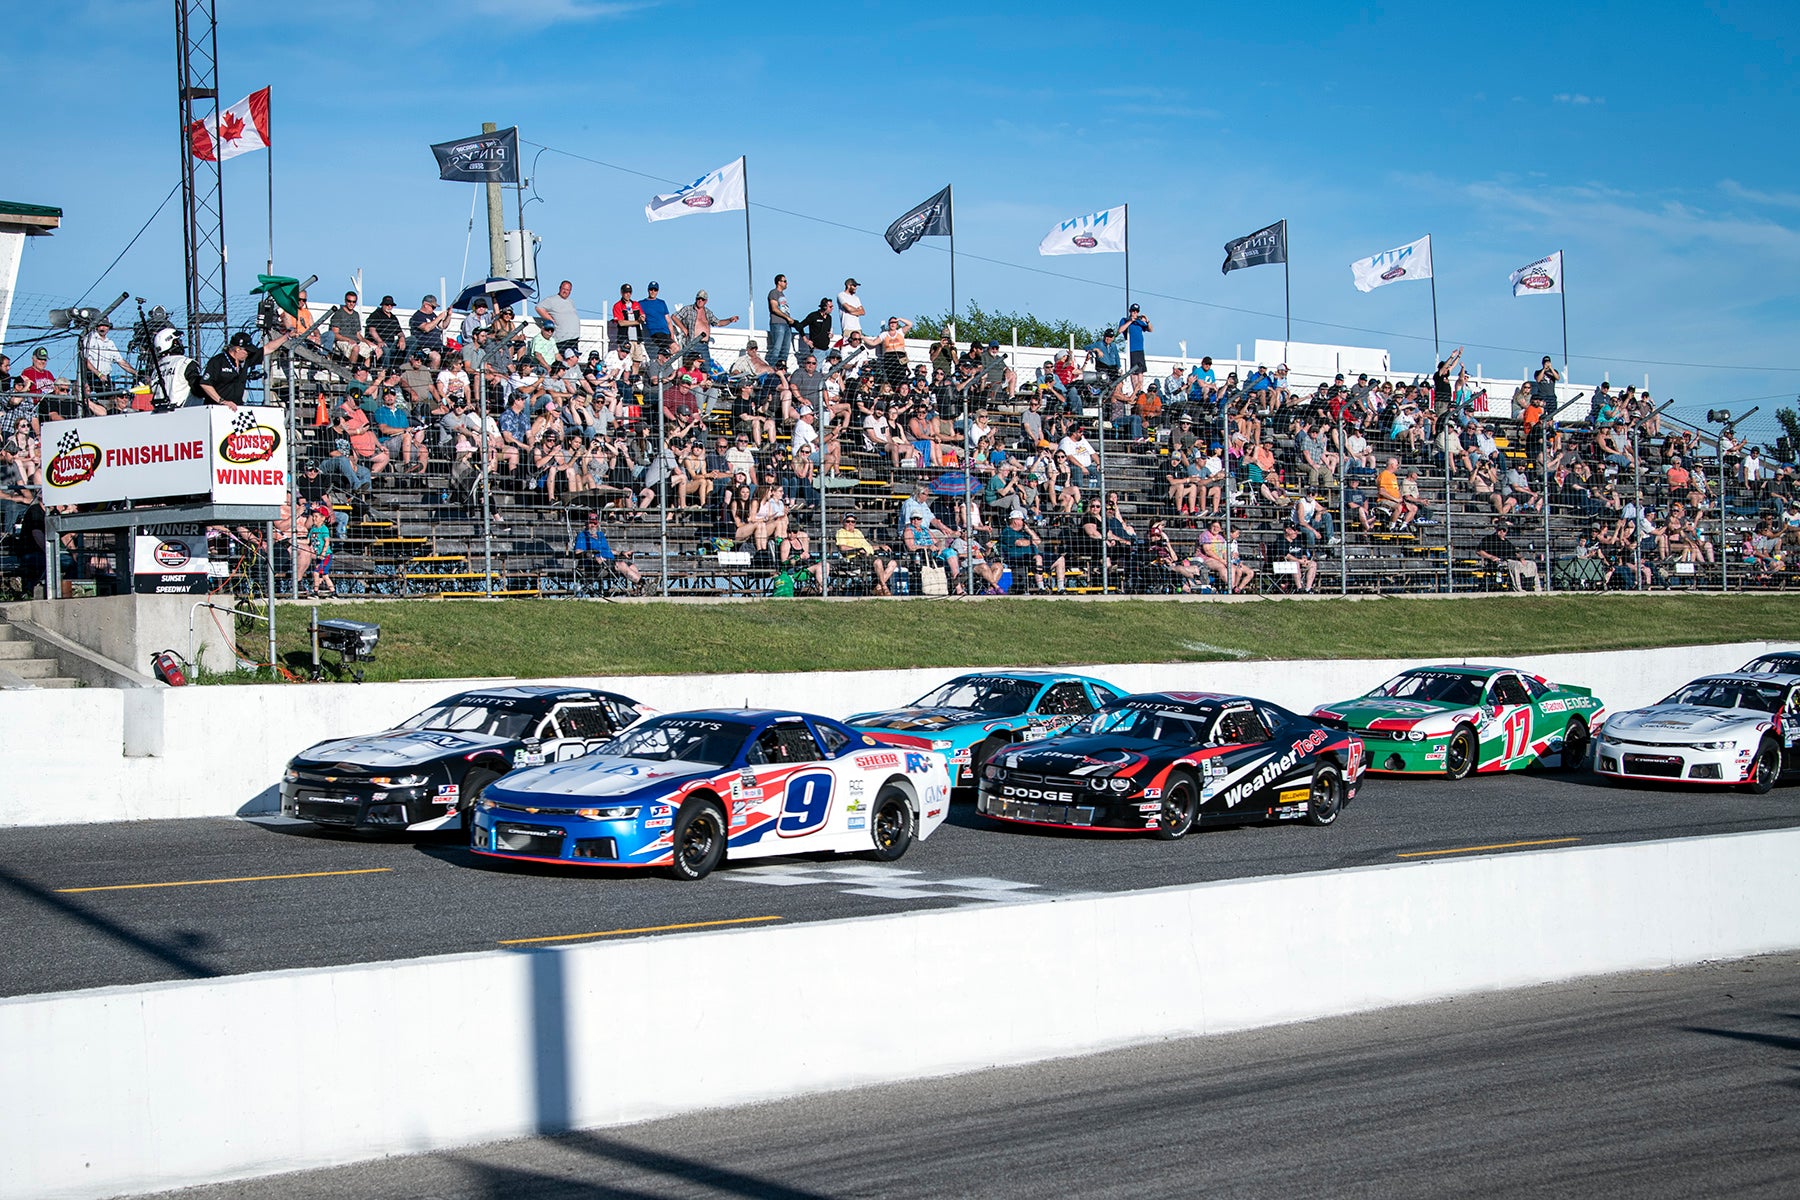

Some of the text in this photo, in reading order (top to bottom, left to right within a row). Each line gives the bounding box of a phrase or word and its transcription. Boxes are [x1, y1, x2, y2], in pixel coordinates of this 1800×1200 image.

[228, 433, 274, 455] SUNSET
[106, 440, 204, 468] FINISHLINE
[53, 453, 95, 476] SUNSET
[216, 468, 285, 486] WINNER
[144, 523, 200, 535] WINNER
[161, 574, 187, 582] SUNSET
[155, 585, 191, 593] SPEEDWAY
[1708, 679, 1760, 687] PINTY'S
[459, 696, 517, 707] PINTY'S
[1126, 702, 1185, 713] PINTY'S
[1565, 697, 1592, 710] EDGE
[660, 720, 722, 731] PINTY'S
[1504, 707, 1530, 761] 17
[855, 753, 899, 767] SHEAR
[1224, 729, 1329, 808] WeatherTech
[1003, 786, 1073, 801] DODGE
[778, 771, 834, 833] 9
[653, 805, 669, 815] JE
